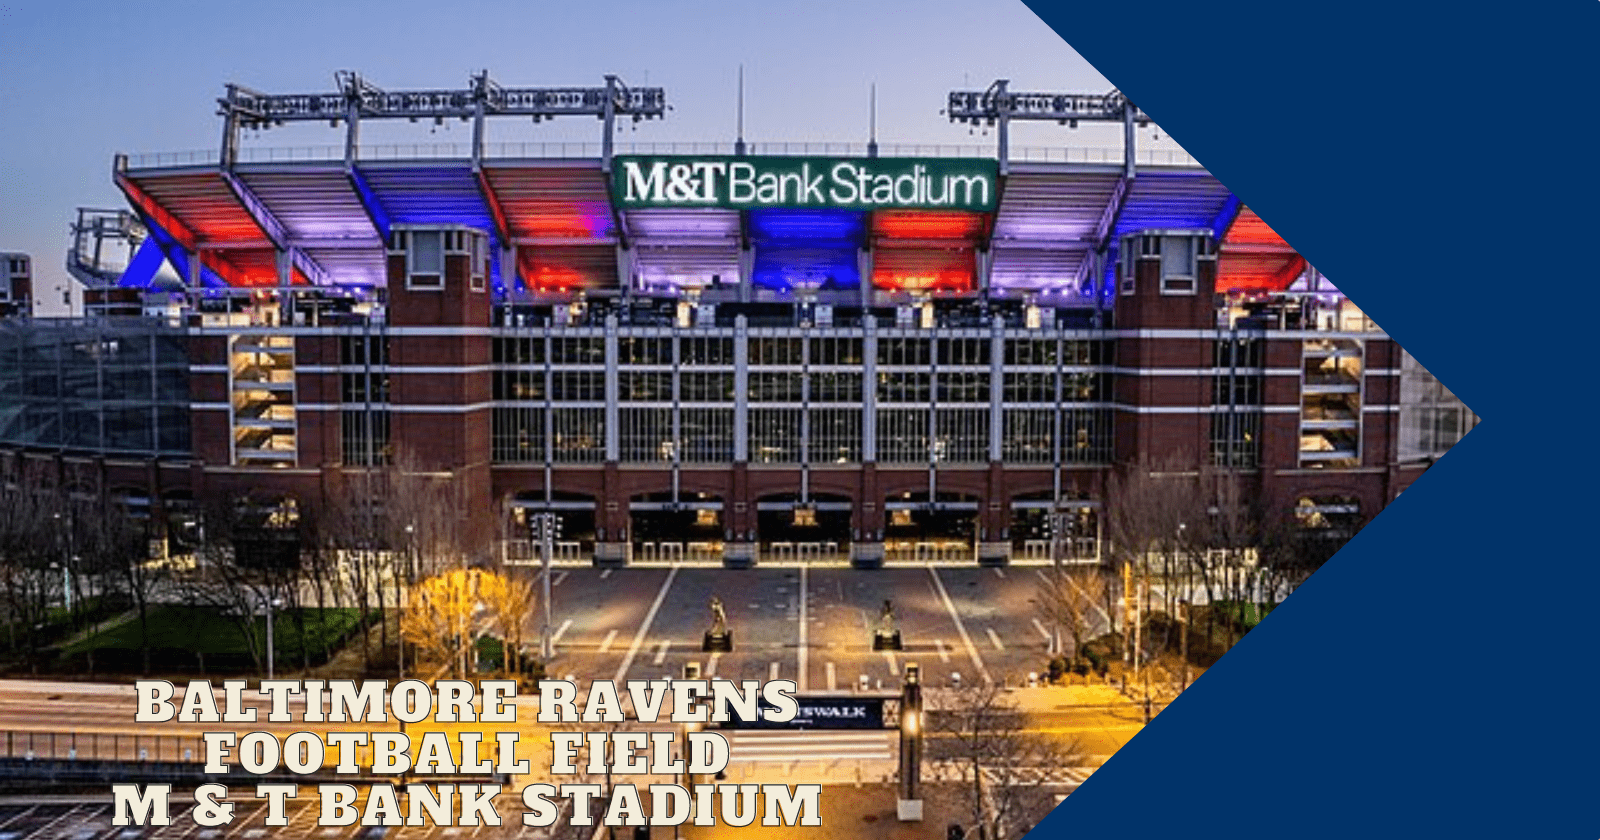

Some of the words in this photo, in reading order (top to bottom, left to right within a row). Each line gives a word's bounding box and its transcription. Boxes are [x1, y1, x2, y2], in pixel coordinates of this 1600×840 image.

[623, 161, 725, 201] M&T
[729, 161, 824, 204] Bank
[829, 162, 989, 206] Stadium
